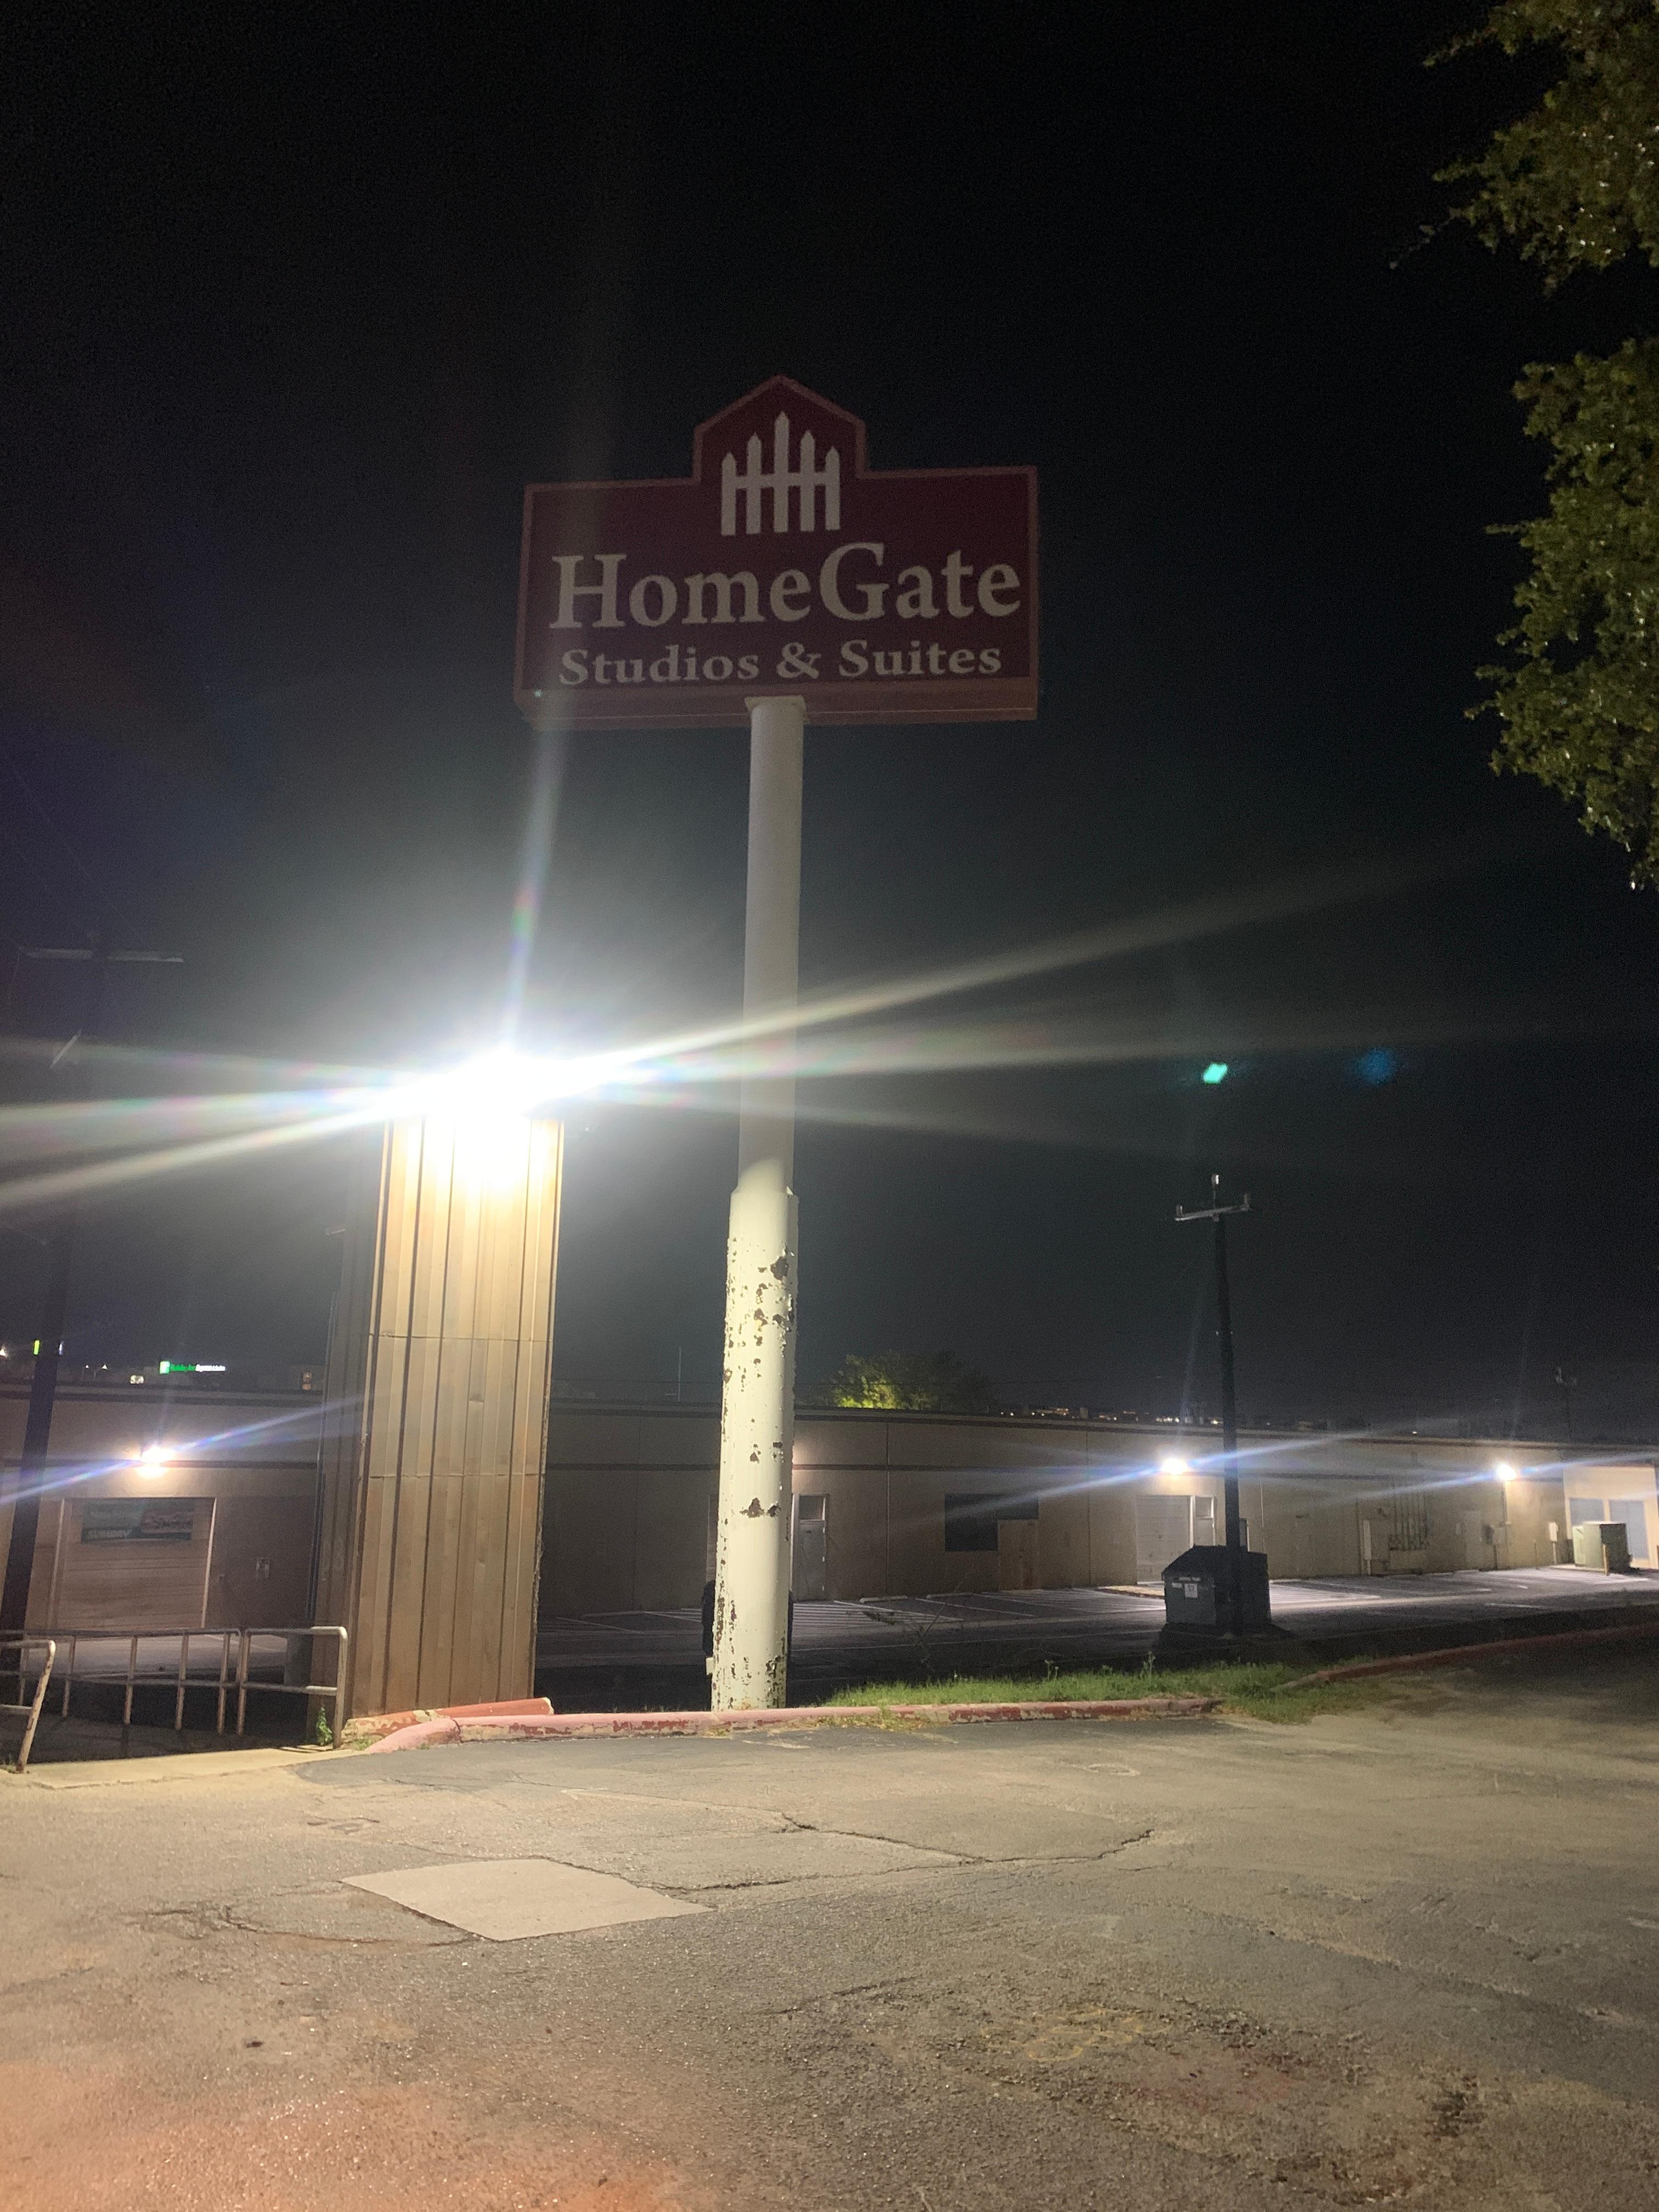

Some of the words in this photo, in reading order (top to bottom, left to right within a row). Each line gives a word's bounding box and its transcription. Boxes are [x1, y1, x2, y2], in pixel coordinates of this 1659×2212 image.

[549, 542, 1021, 629] HomeGate
[558, 644, 759, 686] Studios
[776, 641, 821, 679] &
[838, 638, 1002, 678] Suites
